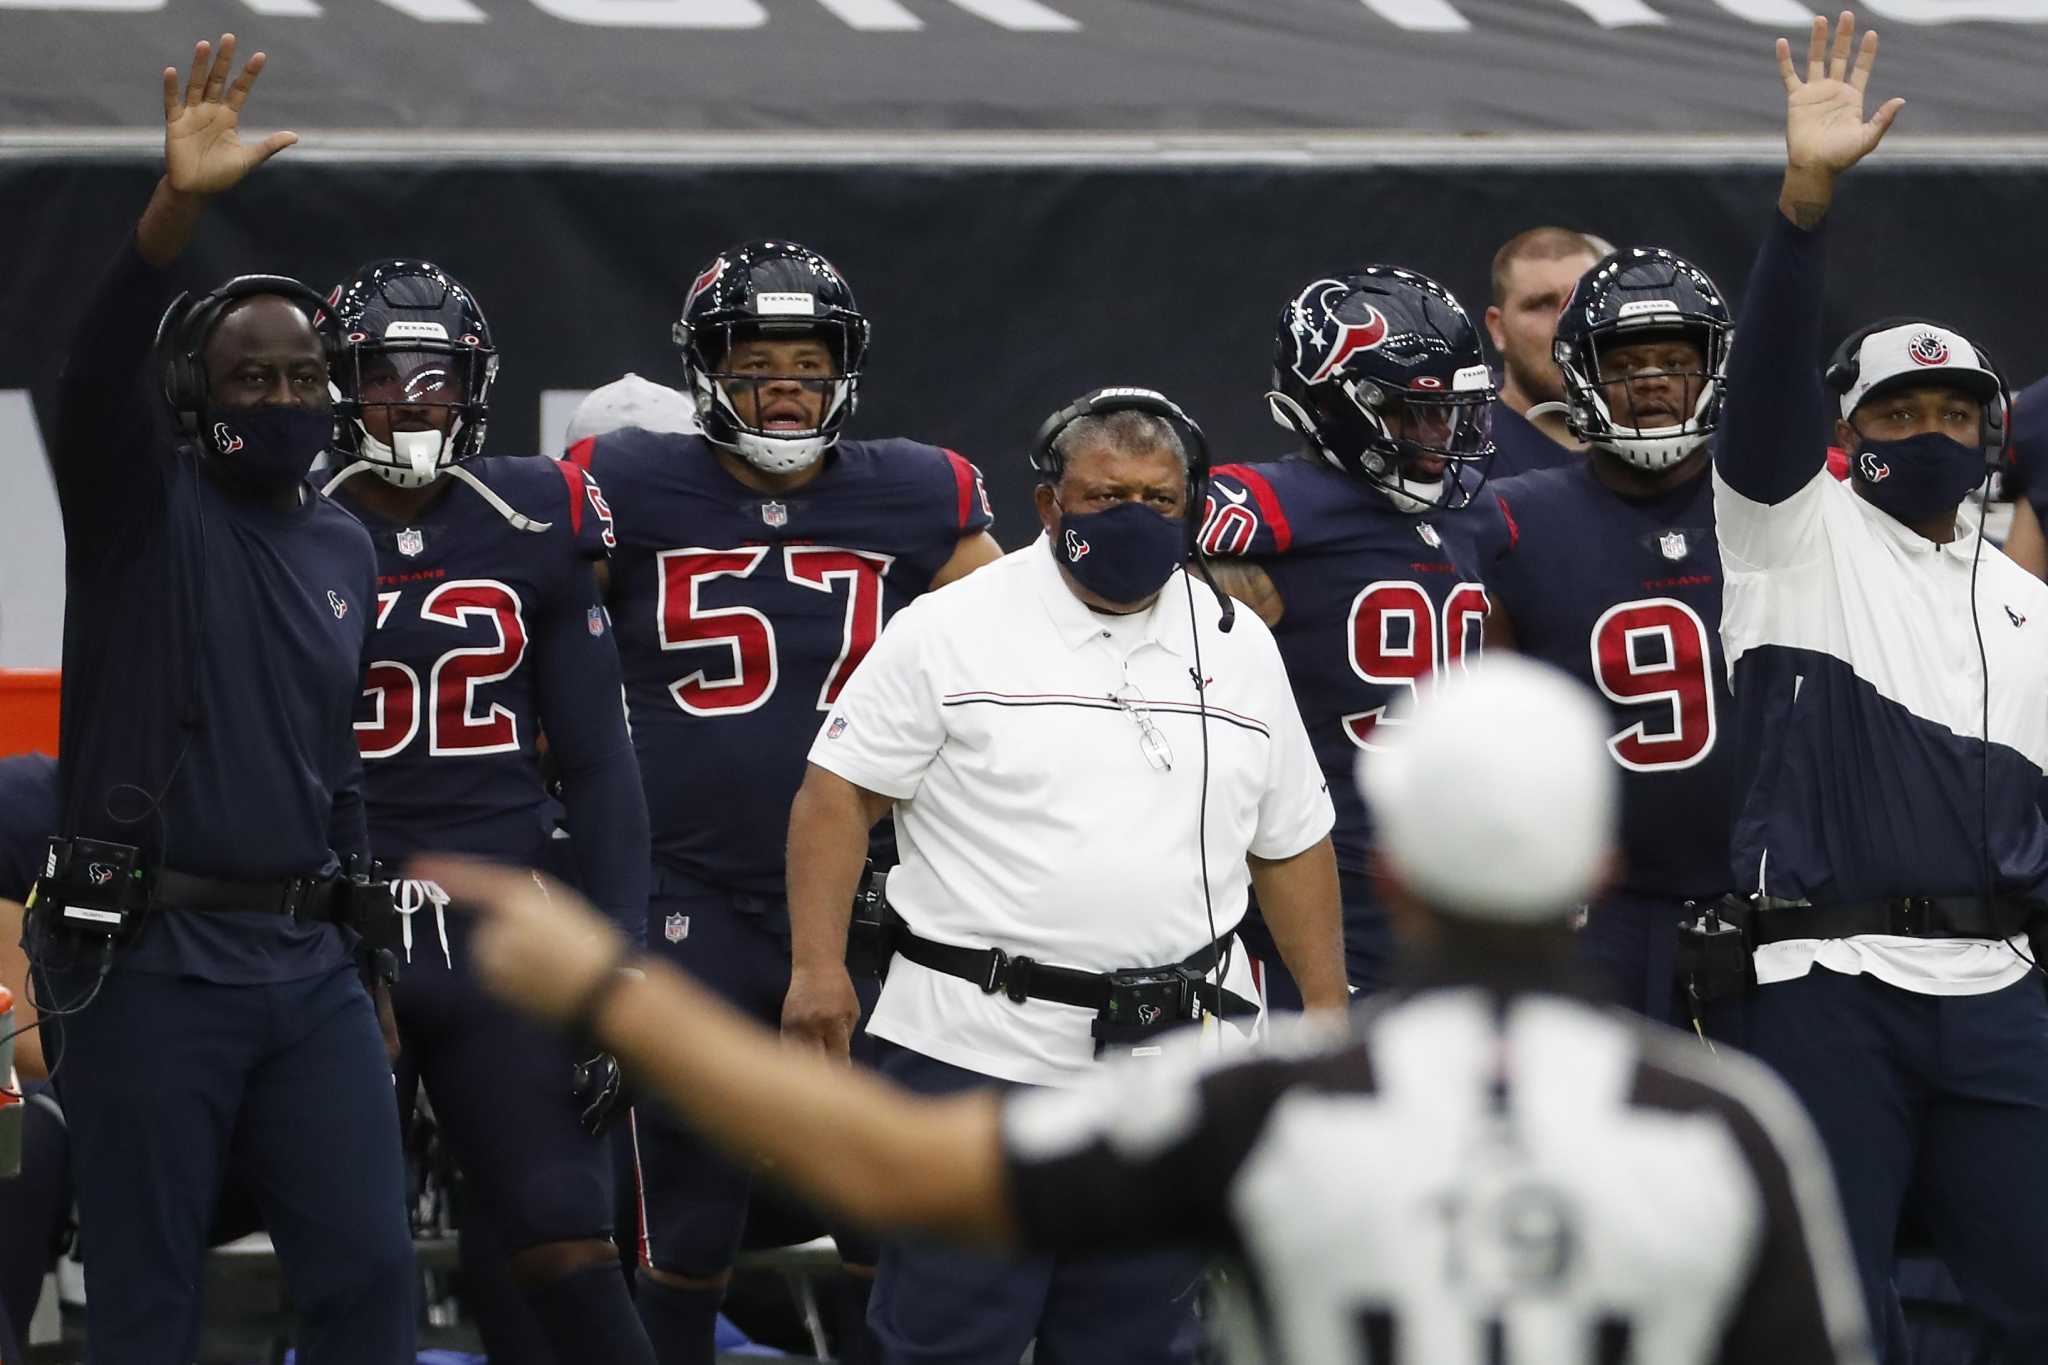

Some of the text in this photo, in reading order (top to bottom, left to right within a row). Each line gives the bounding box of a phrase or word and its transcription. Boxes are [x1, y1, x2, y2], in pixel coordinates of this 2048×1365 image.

[353, 579, 529, 759] 52
[656, 545, 897, 717] 57
[1341, 580, 1492, 752] 90
[1590, 597, 1717, 772] 9
